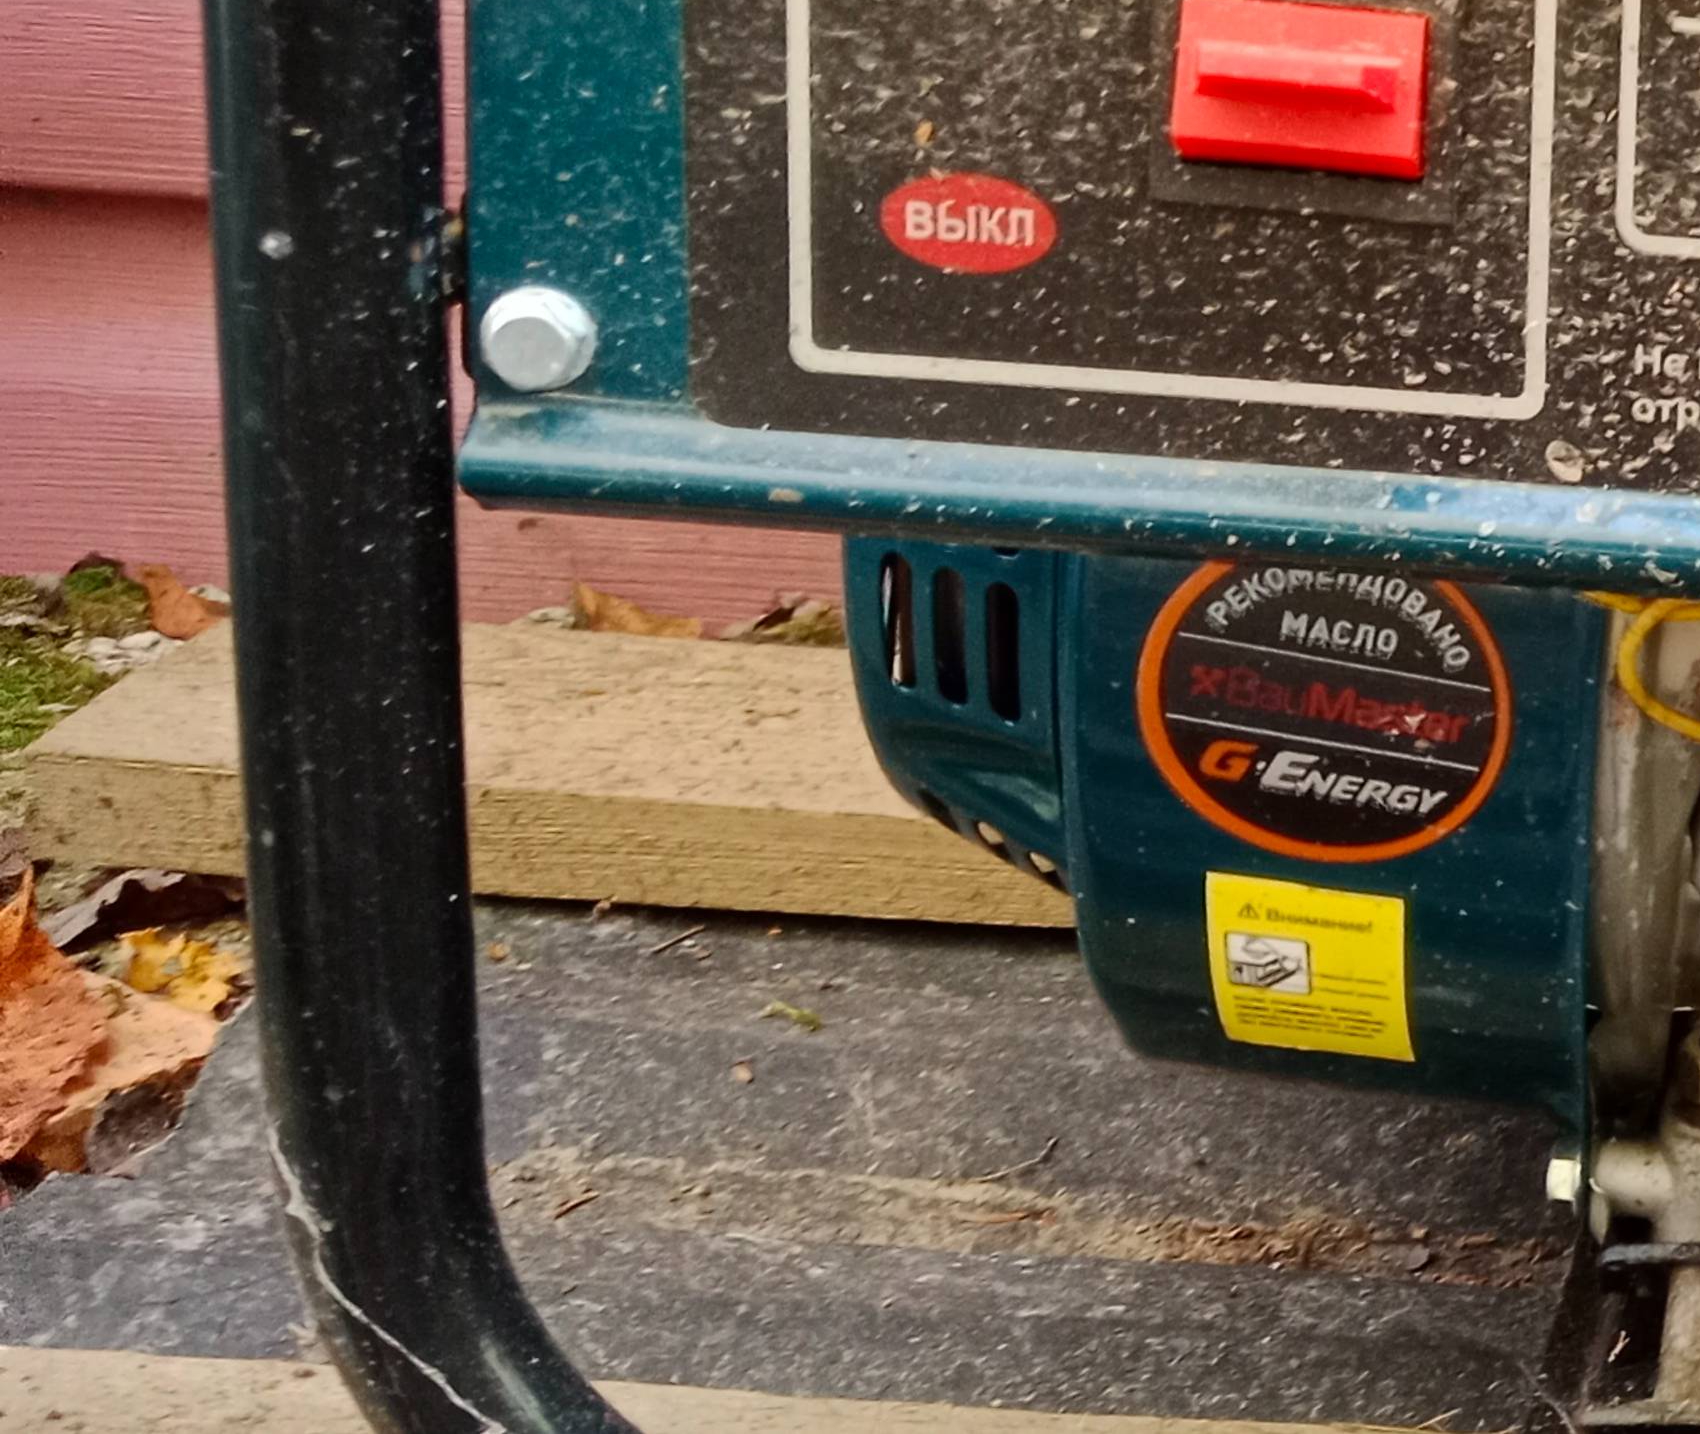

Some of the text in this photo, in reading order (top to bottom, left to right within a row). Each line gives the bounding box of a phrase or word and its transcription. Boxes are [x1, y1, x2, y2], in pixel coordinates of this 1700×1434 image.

[1634, 343, 1691, 378] Не
[1278, 609, 1399, 659] МАСЛО
[1226, 666, 1471, 744] BauMaster
